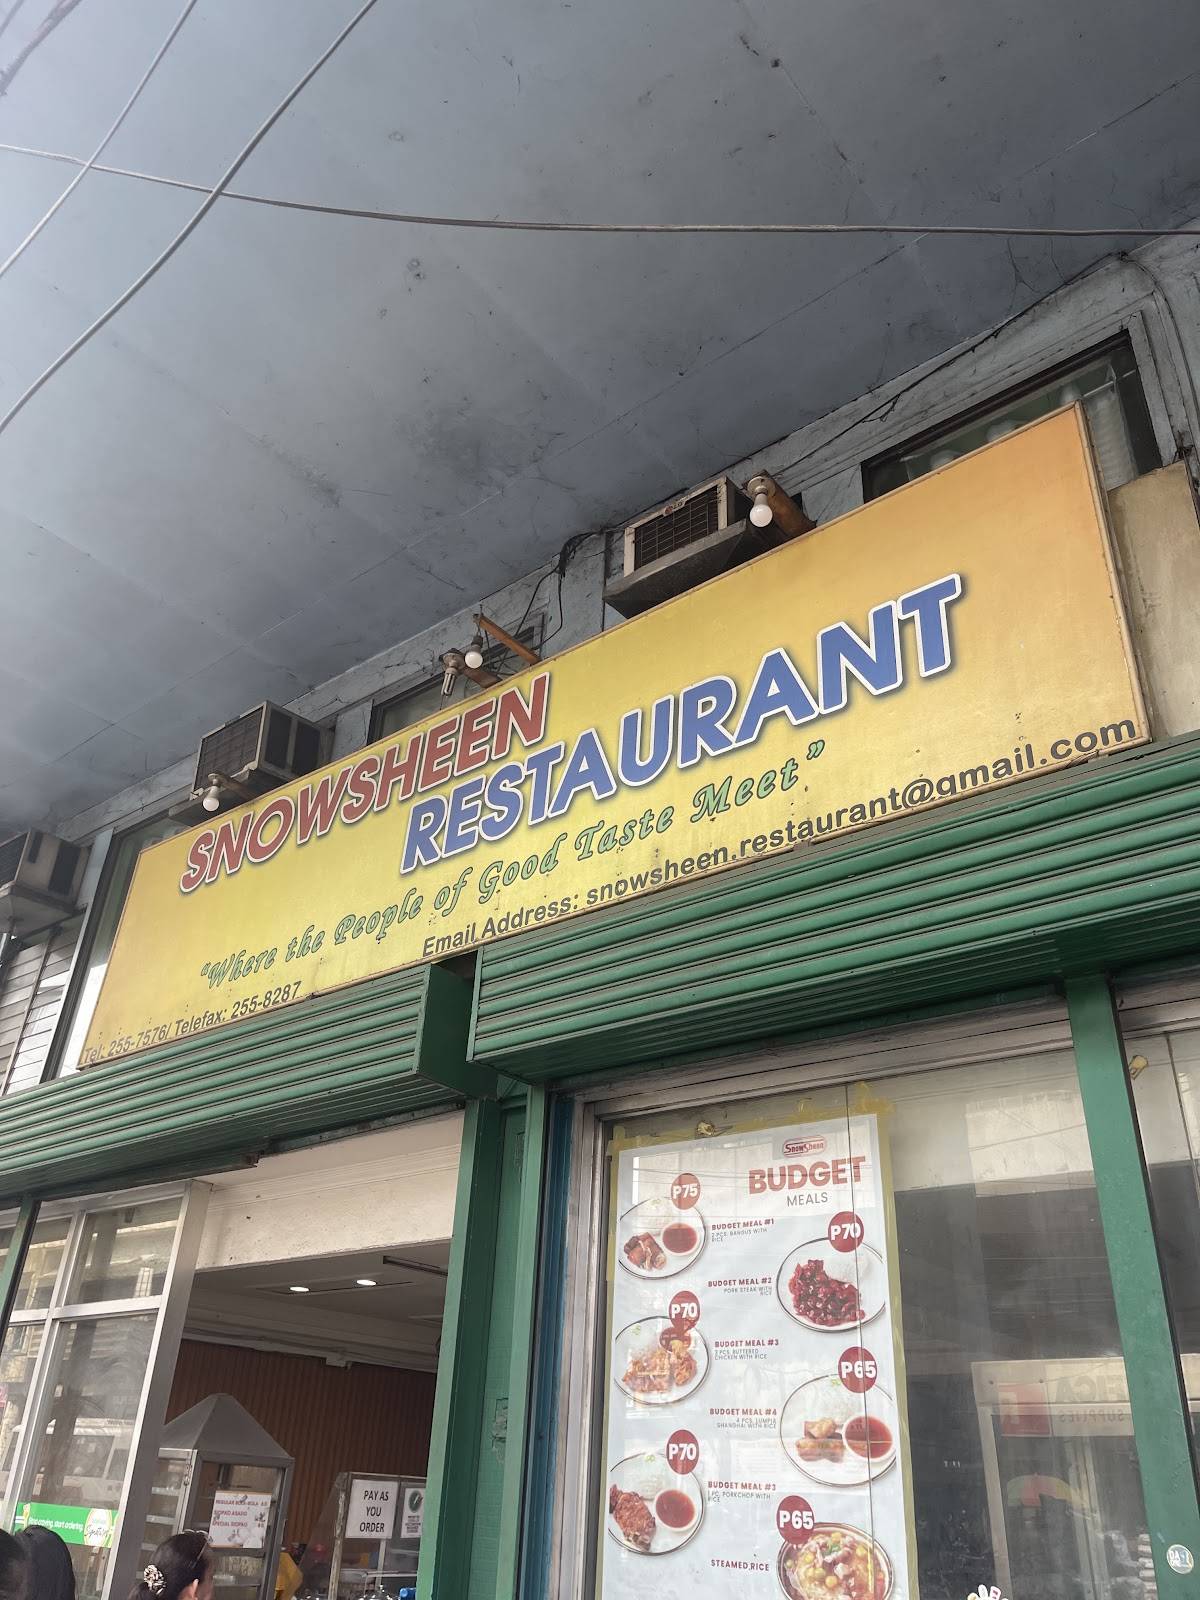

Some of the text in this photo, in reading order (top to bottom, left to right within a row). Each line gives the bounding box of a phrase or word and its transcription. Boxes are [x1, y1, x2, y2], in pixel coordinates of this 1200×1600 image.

[400, 573, 962, 874] RESTAURANT
[179, 671, 550, 893] SNOWSHEEN
[422, 718, 1136, 957] Email Address: snowsheen.restaurant@gmail.com
[285, 924, 326, 963] the
[334, 887, 424, 945] People
[433, 867, 474, 918] of
[478, 832, 568, 904] Good
[574, 806, 675, 861] Taste
[174, 1008, 228, 1036] Telefax:
[230, 981, 302, 1020] 255-8287
[748, 1155, 866, 1195] BUDGET
[671, 1180, 698, 1200] P75
[786, 1191, 829, 1207] MEALS
[711, 1218, 775, 1231] BUDGET MEAL #1
[829, 1221, 862, 1241] P70
[707, 1277, 772, 1288] BUDGET MEAL #2
[670, 1301, 698, 1319] P70
[714, 1340, 744, 1348] BUDGET
[744, 1339, 766, 1347] MEAL
[840, 1360, 877, 1379] P65
[709, 1408, 741, 1416] BUDGET
[741, 1408, 763, 1416] MEAL
[668, 1443, 697, 1461] P70
[707, 1481, 739, 1490] BUDGET
[740, 1482, 763, 1491] MEAL
[363, 1490, 389, 1502] PAY AS
[366, 1506, 382, 1517] YOU
[778, 1510, 814, 1530] P65
[359, 1521, 385, 1533] ORDER
[710, 1559, 770, 1572] STEAMED RICE
